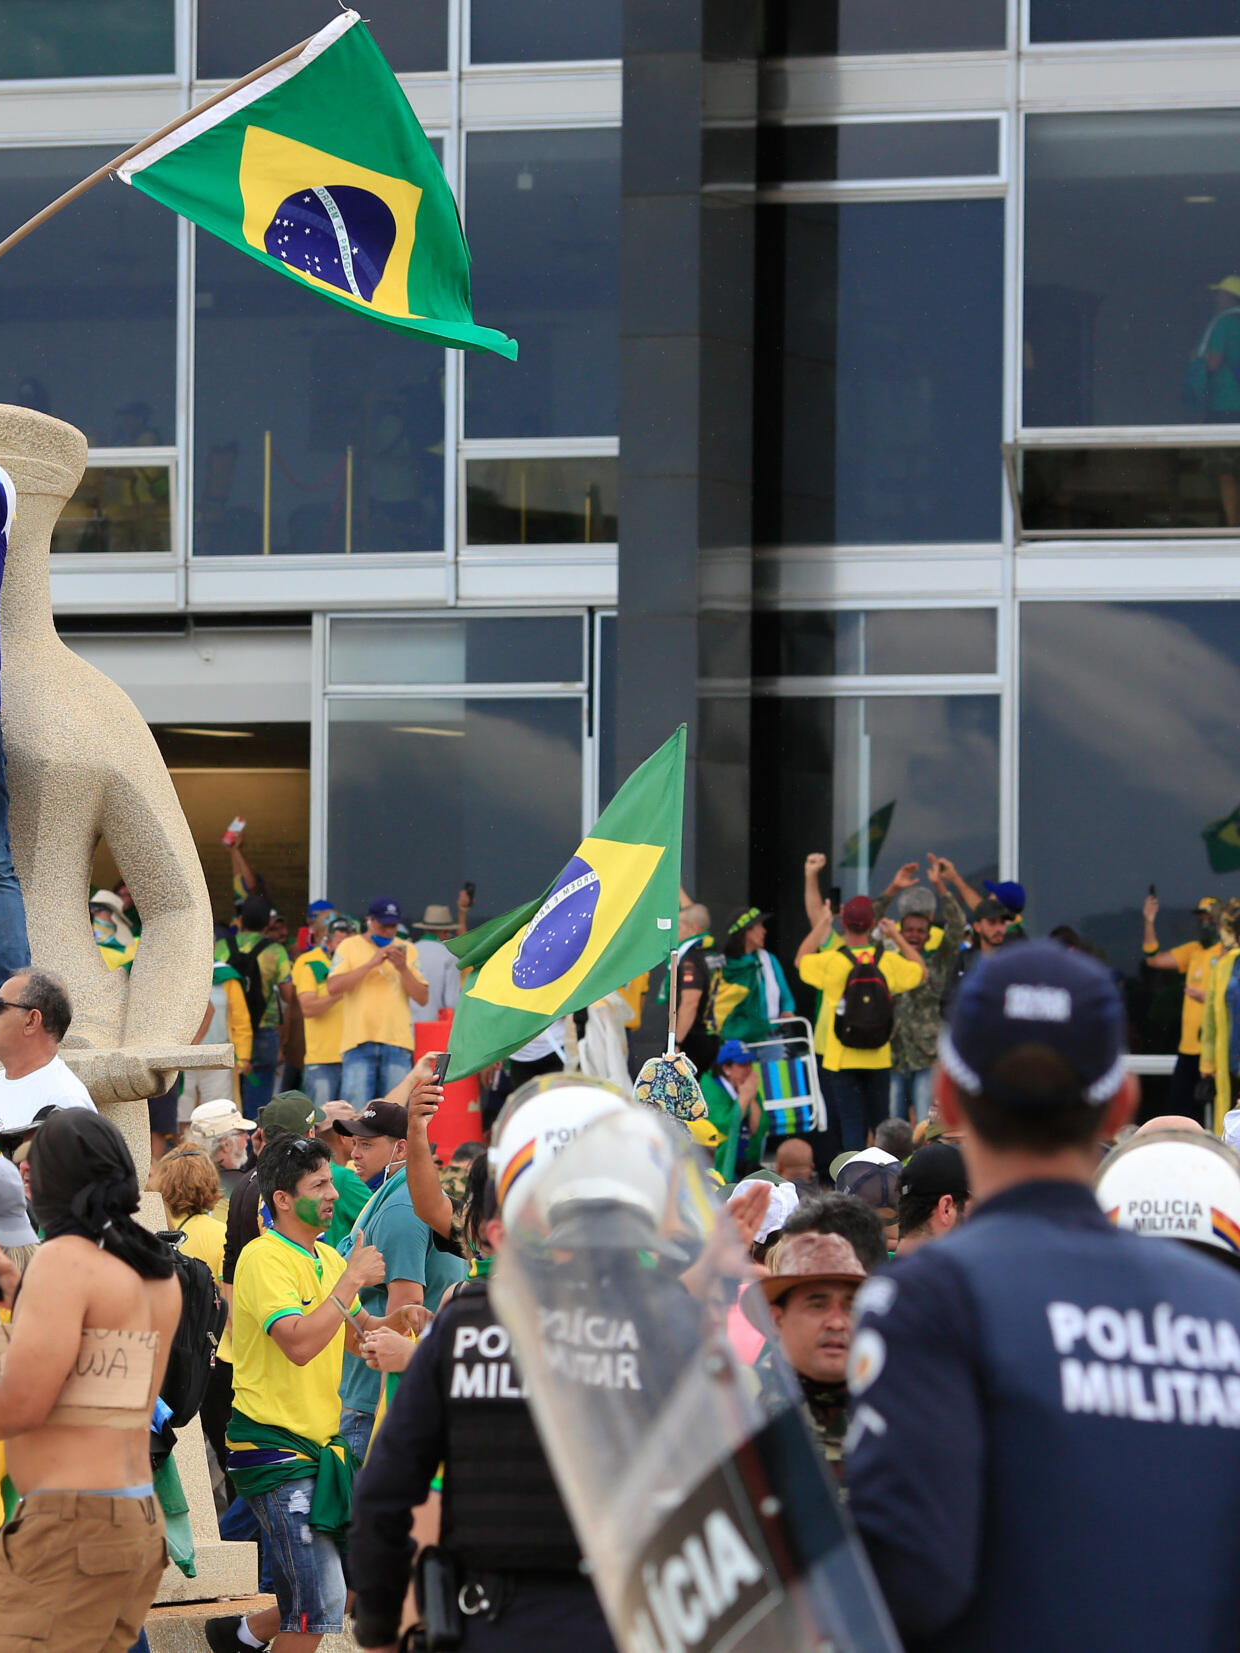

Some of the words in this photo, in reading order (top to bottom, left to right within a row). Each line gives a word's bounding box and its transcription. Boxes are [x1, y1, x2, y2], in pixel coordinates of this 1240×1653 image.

[316, 188, 340, 219] ORDEM
[336, 225, 344, 233] E
[1134, 1217, 1198, 1231] MILITAR
